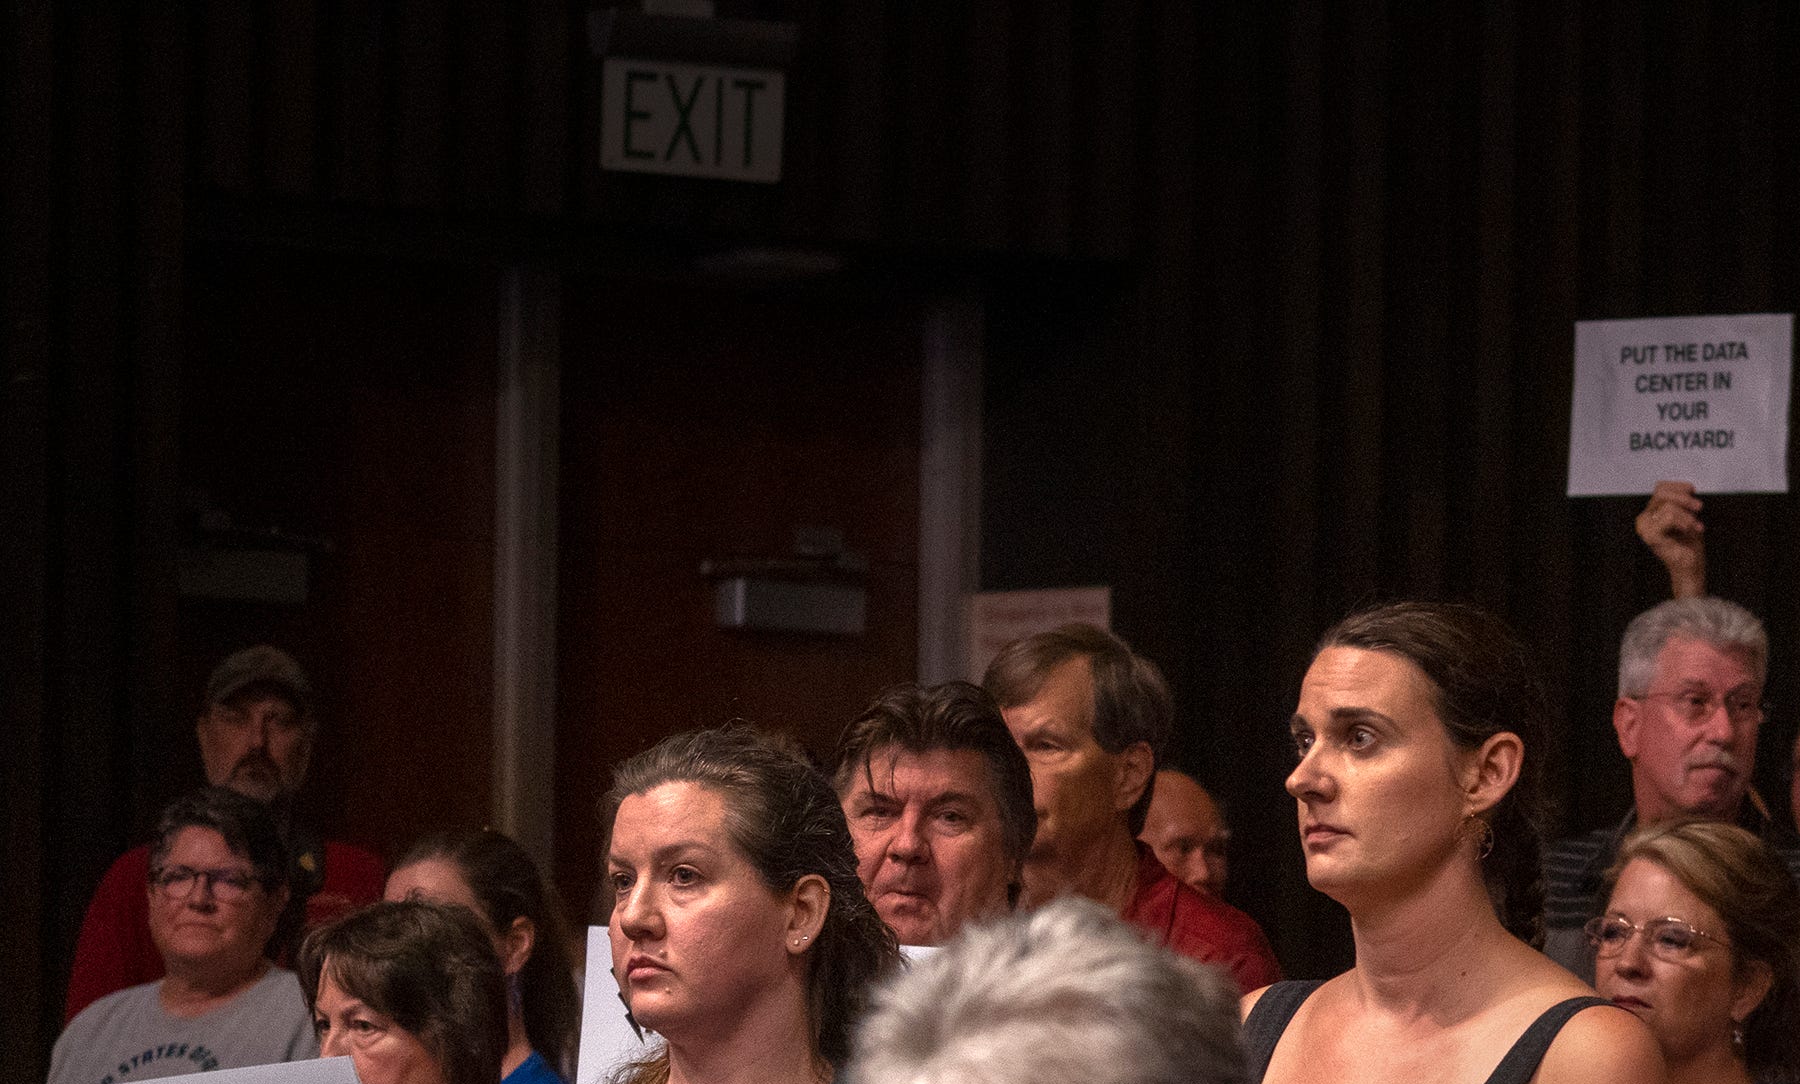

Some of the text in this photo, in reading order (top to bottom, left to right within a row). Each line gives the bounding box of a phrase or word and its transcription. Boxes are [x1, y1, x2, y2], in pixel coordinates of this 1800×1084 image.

[623, 69, 767, 167] EXIT
[1620, 342, 1748, 364] PUT THE DATA
[1635, 372, 1731, 393] CENTER IN
[1656, 402, 1708, 421] YOUR
[1629, 430, 1735, 451] BACKYARD!
